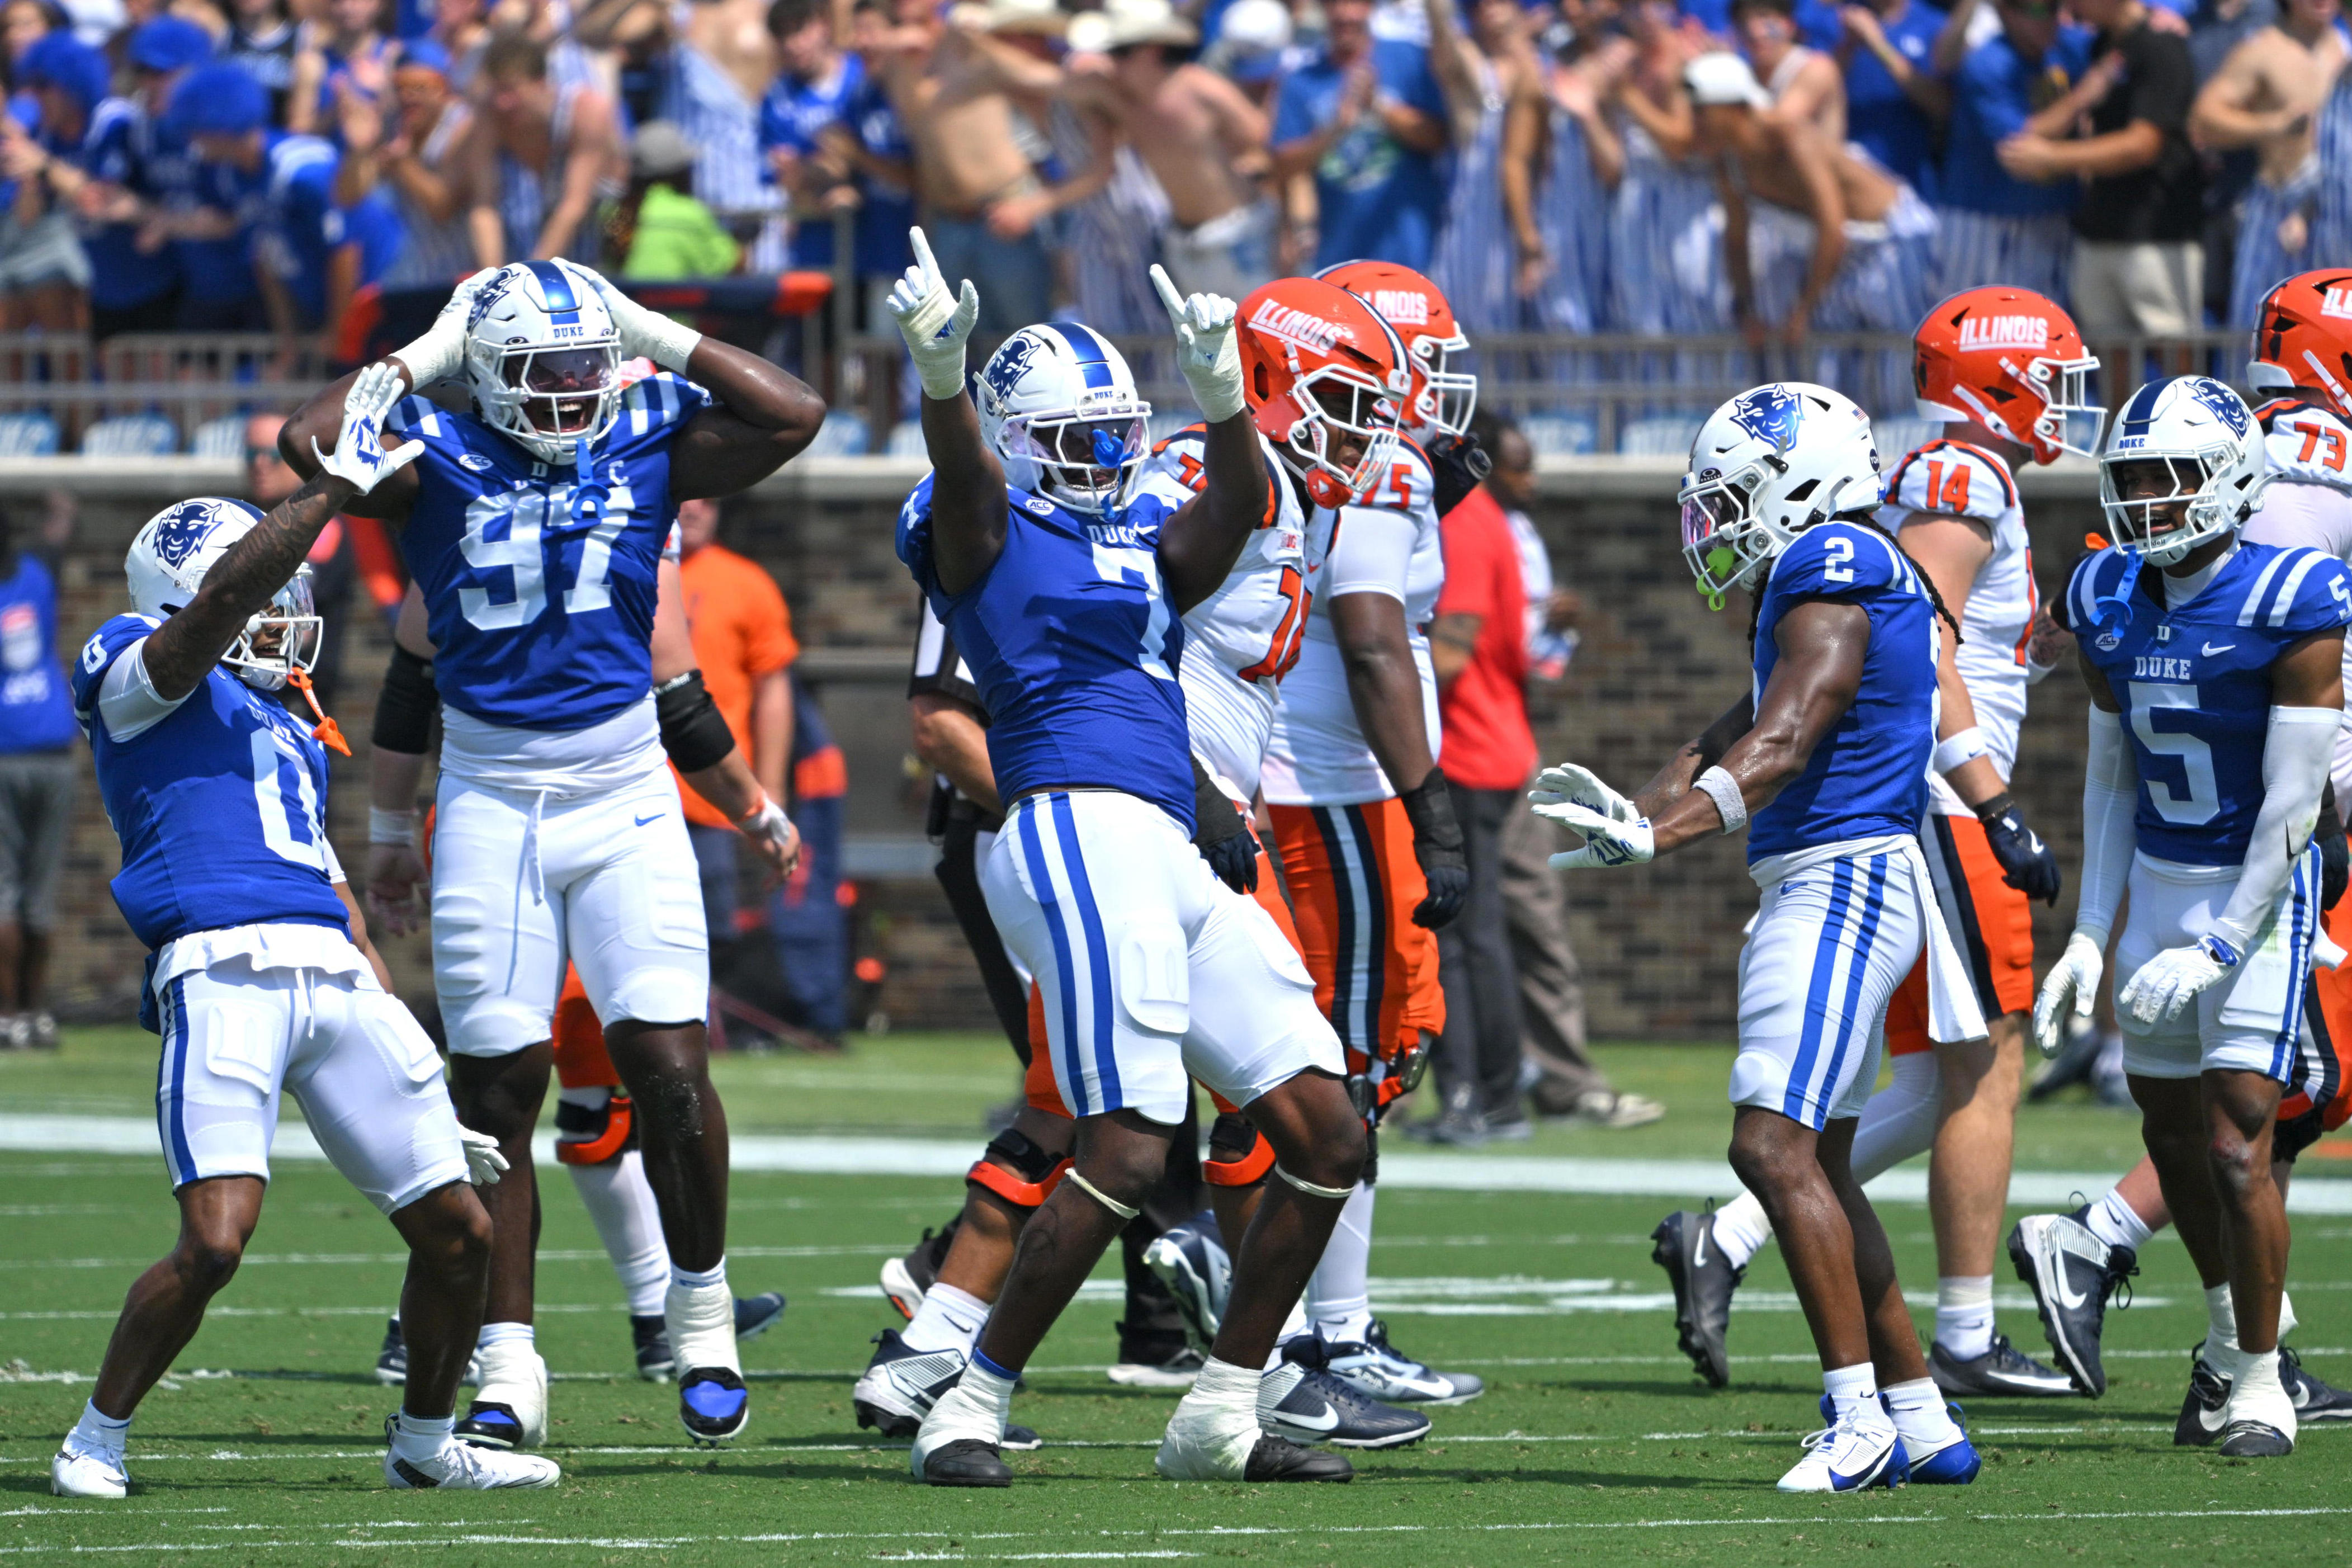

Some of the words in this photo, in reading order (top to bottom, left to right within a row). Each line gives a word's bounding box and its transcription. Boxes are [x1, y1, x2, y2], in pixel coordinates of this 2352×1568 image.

[554, 327, 584, 338] DUKE
[1250, 299, 1336, 351] ILLINOIS
[1960, 315, 2047, 344] ILLINOIS
[1094, 391, 1113, 399] DUKE
[2119, 438, 2145, 449] DUKE
[2294, 421, 2346, 473] 73
[465, 456, 489, 465] ACC
[531, 462, 548, 477] D
[608, 460, 629, 485] C
[1356, 460, 1413, 510] 75
[1700, 474, 1721, 483] OAKLEY
[1926, 460, 1971, 513] 14
[1028, 501, 1050, 509] ACC
[1087, 525, 1142, 547] DUKE
[457, 486, 635, 631] 97
[1824, 537, 1854, 583] 2
[2327, 573, 2352, 621] 5
[1092, 542, 1175, 682] 7
[2157, 625, 2170, 641] D
[82, 634, 108, 674] 0
[2135, 657, 2191, 680] DUKE
[2128, 681, 2221, 826] 5
[251, 726, 328, 873] 0
